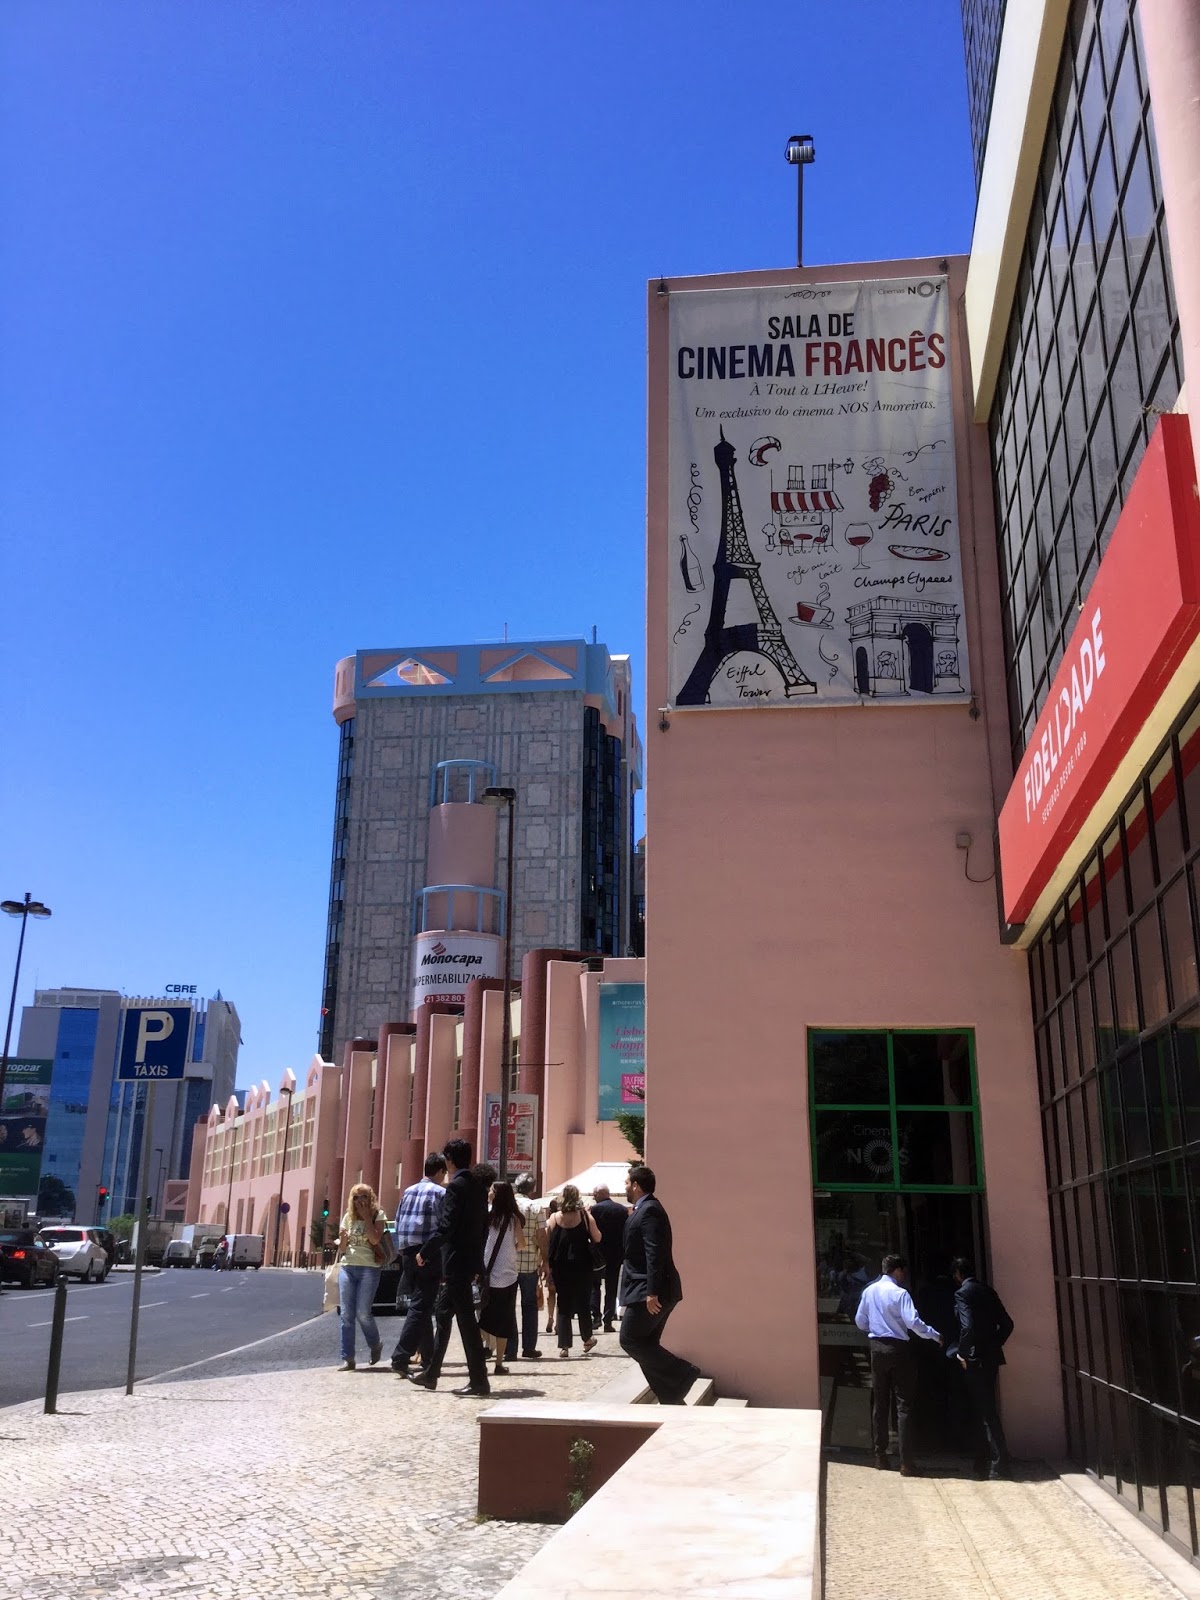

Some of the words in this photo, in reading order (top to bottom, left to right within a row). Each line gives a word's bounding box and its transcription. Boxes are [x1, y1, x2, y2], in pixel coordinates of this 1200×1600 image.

[908, 281, 941, 298] NOS
[768, 314, 822, 340] SALA
[829, 312, 854, 336] DE
[678, 344, 796, 380] CINEMA
[805, 330, 946, 377] FRANCÊS
[749, 382, 760, 396] À
[767, 383, 796, 396] Tout
[801, 385, 809, 396] à
[695, 407, 716, 418] Um
[719, 405, 772, 419] exclusivo
[775, 406, 789, 417] do
[792, 405, 834, 417] cinema
[838, 402, 869, 415] NOS
[872, 400, 936, 413] Amoreiras.
[908, 486, 924, 497] Bon
[878, 502, 952, 536] PARIS
[853, 576, 905, 589] Champs
[726, 663, 766, 683] Eiffel
[735, 685, 772, 699] Tower
[1059, 755, 1074, 790] DESDE
[421, 954, 483, 967] Monocapa
[165, 984, 197, 993] CBRE
[451, 994, 461, 1002] 80
[135, 1011, 175, 1063] P
[609, 1040, 645, 1051] shopp
[6, 1063, 42, 1073] ropcar
[134, 1065, 168, 1076] TAXIS
[490, 1102, 517, 1118] RD
[490, 1115, 516, 1127] SAES
[846, 1139, 910, 1173] NOS
